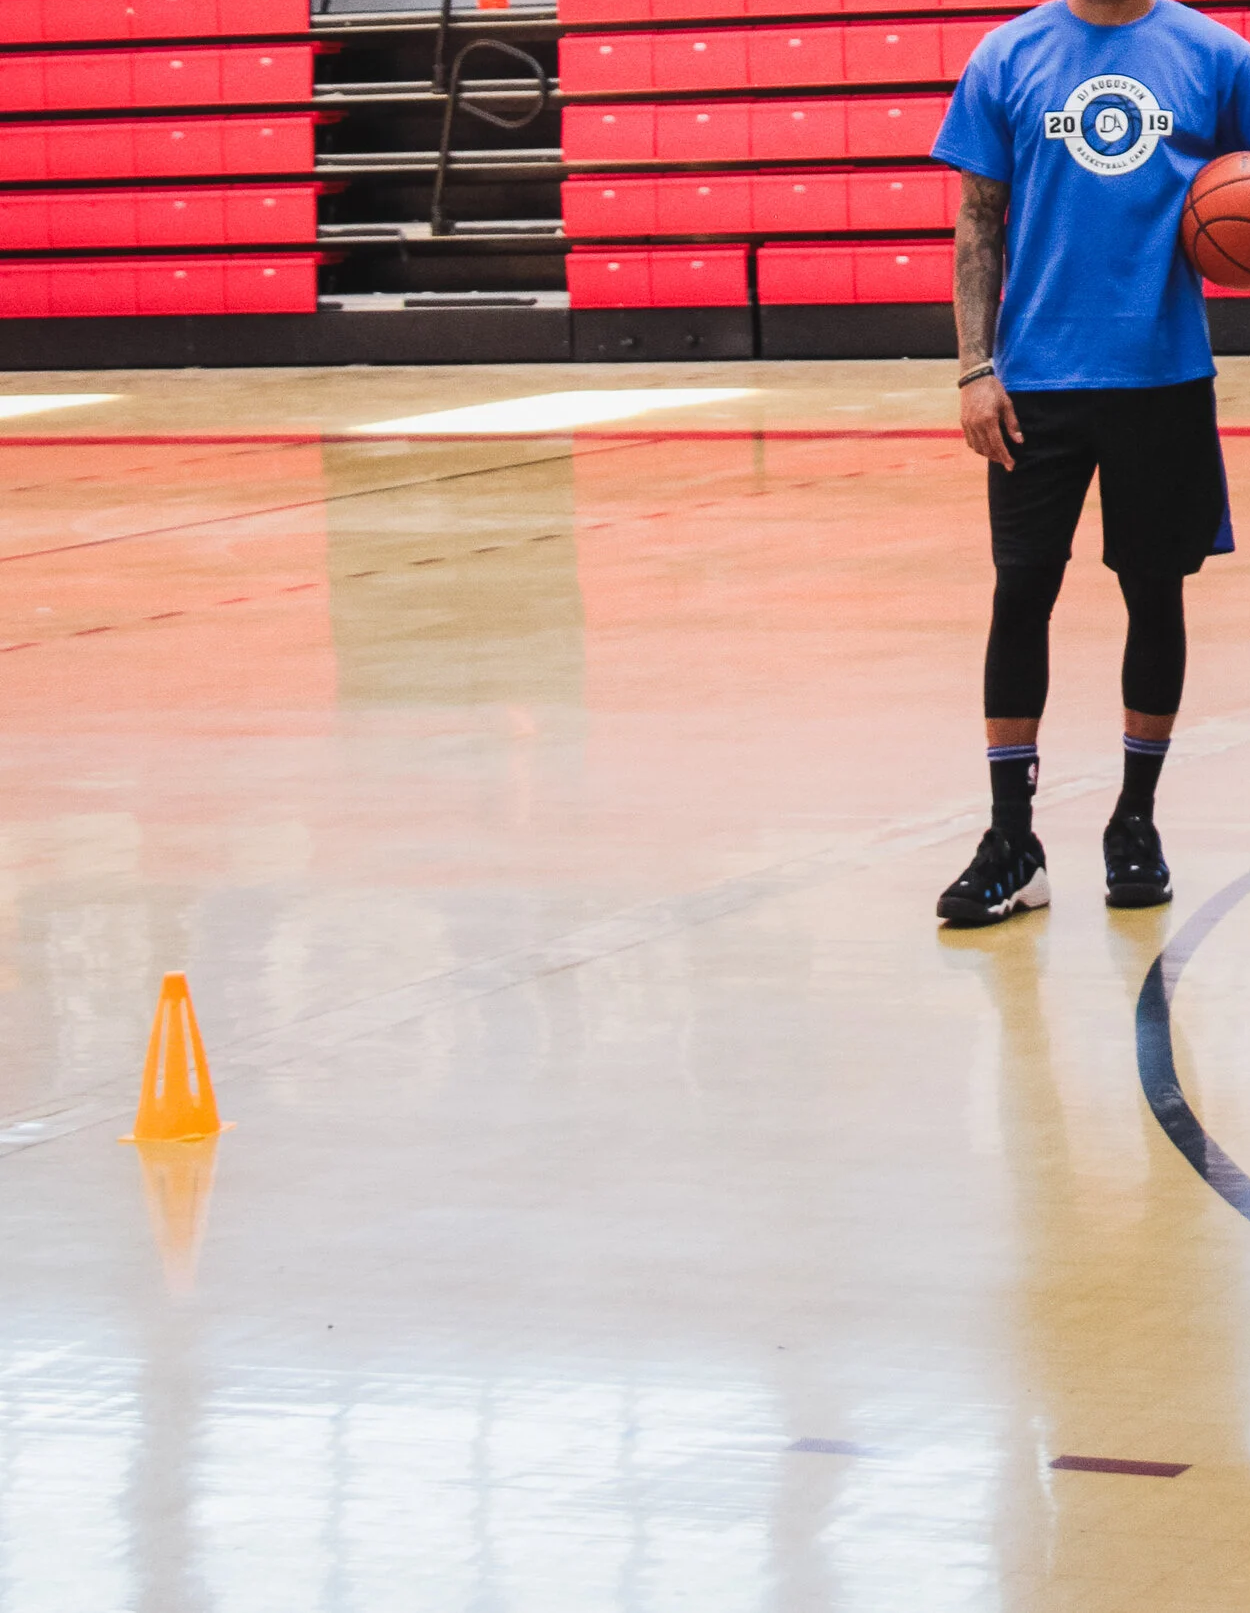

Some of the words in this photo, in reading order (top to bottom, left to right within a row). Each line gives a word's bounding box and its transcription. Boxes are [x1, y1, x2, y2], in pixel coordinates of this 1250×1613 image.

[1091, 79, 1146, 100] AUGUSTIN
[1050, 116, 1075, 133] 20
[1149, 115, 1168, 130] 19
[1077, 147, 1128, 169] BASKETBALL
[1130, 144, 1148, 162] CAMP
